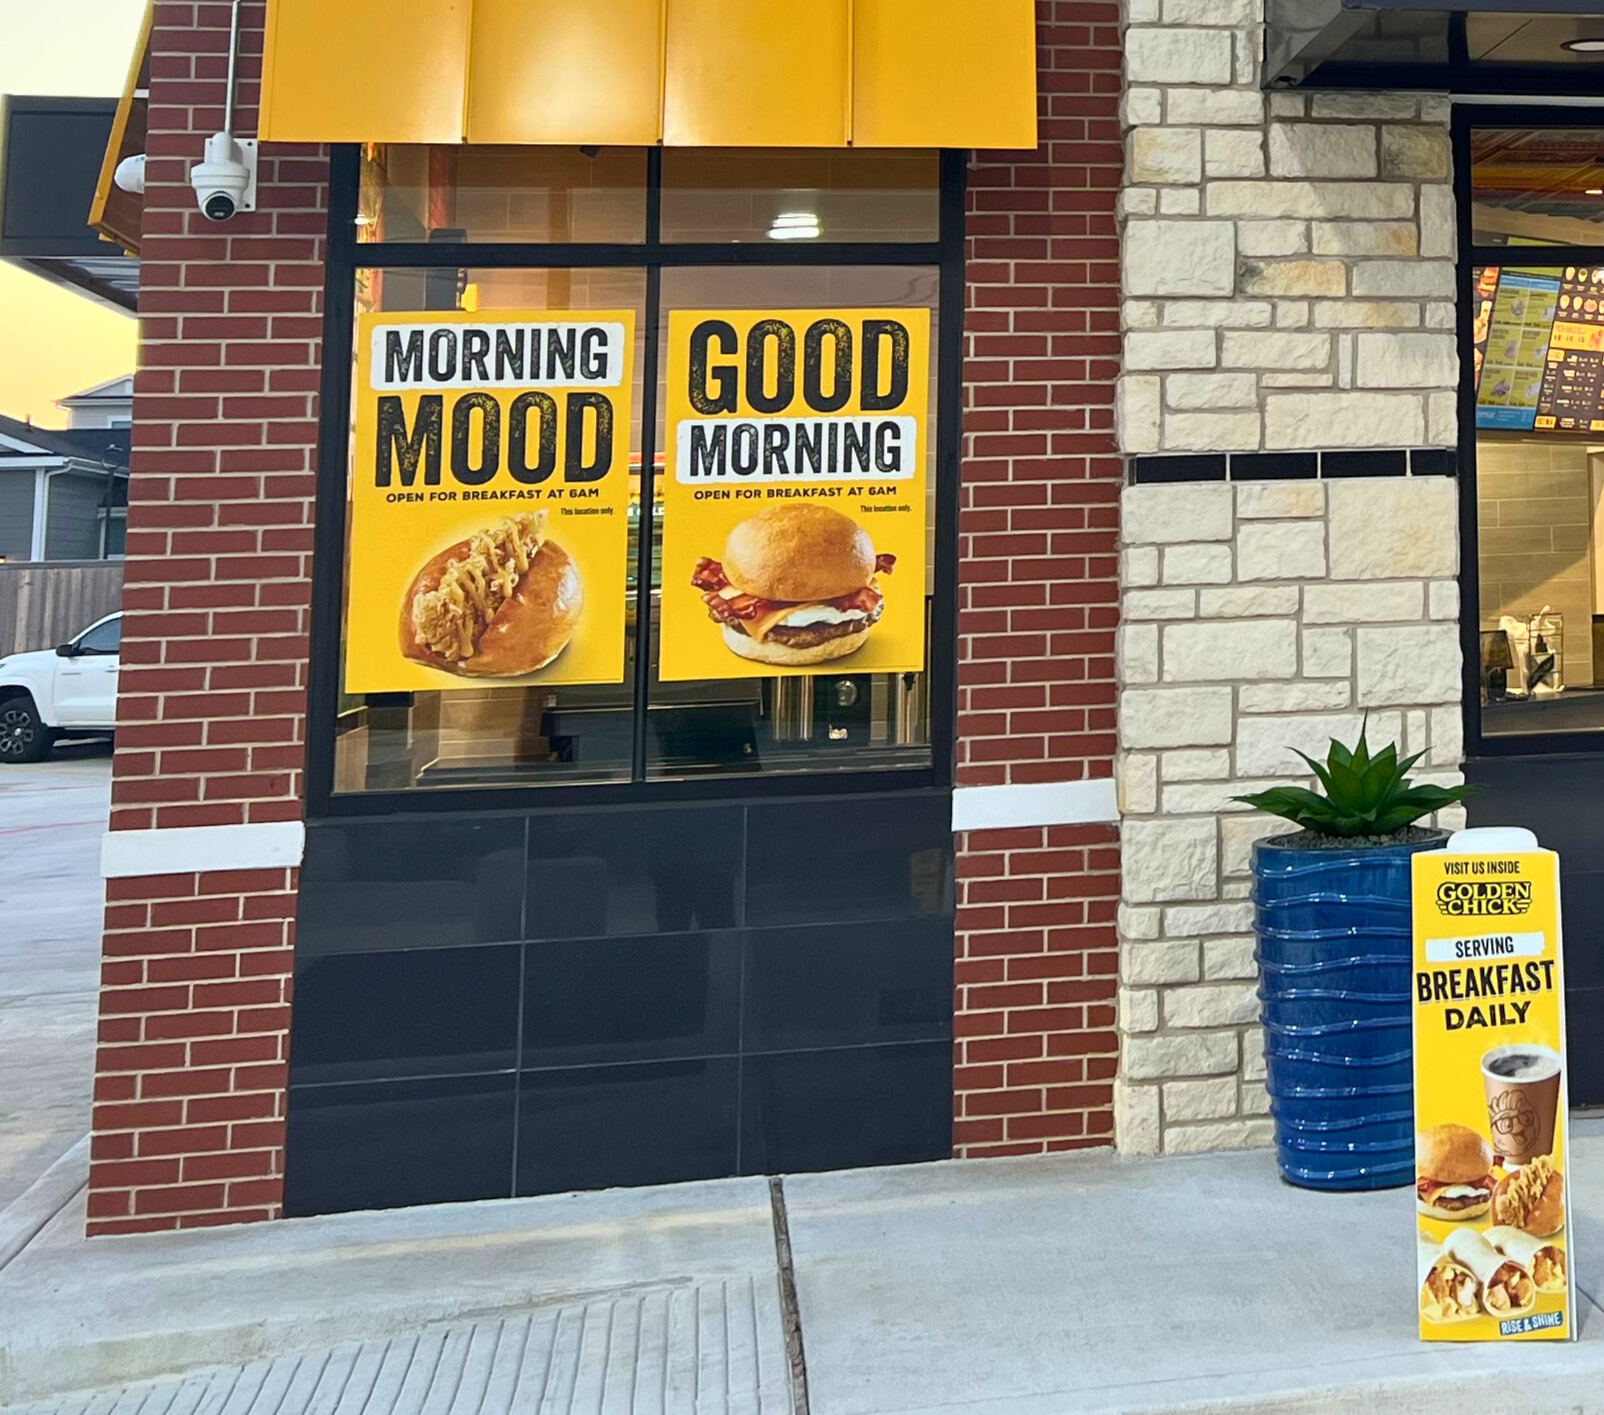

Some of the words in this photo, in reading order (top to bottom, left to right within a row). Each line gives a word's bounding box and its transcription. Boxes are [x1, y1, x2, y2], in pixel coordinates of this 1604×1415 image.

[385, 327, 609, 383] MORNING
[688, 319, 909, 415] GOOD
[375, 392, 613, 486] MOOD
[690, 421, 901, 476] MORNING
[386, 492, 425, 503] OPEN
[429, 491, 457, 502] FOR
[462, 490, 543, 500] BREAKFAST
[547, 489, 565, 499] AT
[569, 488, 600, 499] 6AM
[694, 490, 731, 500] OPEN
[735, 489, 762, 499] FOR
[766, 487, 843, 498] BREAKFAST
[847, 487, 864, 496] AT
[868, 486, 897, 496] 6AM
[1444, 862, 1470, 875] VISIT
[1471, 862, 1485, 874] US
[1487, 861, 1520, 874] INSIDE
[1438, 882, 1531, 902] GOLDEN
[1448, 898, 1518, 915] CHICK
[1455, 936, 1514, 959] SERVING
[1416, 960, 1554, 1002] BREAKFAST
[1445, 1001, 1531, 1030] DAILY
[1500, 1320, 1523, 1335] RISE
[1524, 1318, 1532, 1331] &
[1532, 1312, 1562, 1329] SHINE
